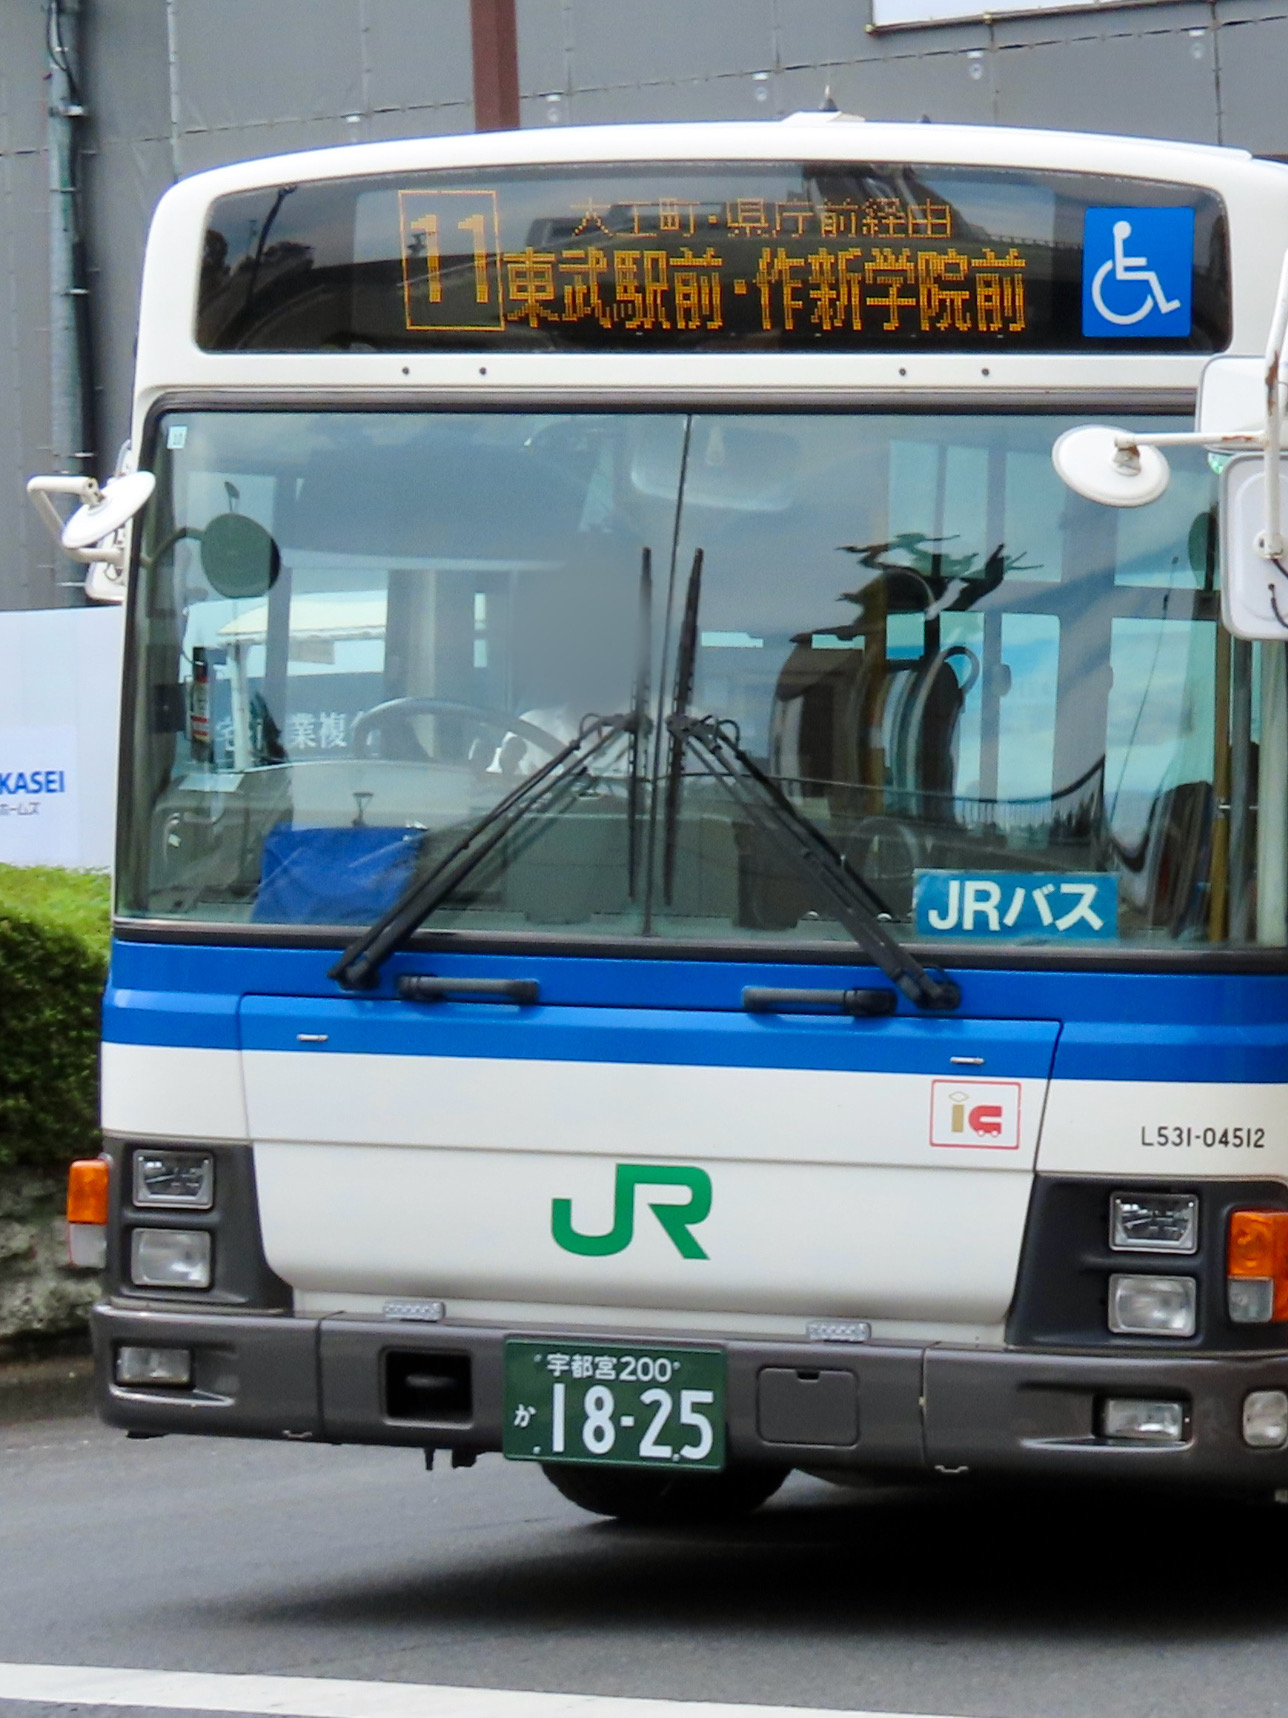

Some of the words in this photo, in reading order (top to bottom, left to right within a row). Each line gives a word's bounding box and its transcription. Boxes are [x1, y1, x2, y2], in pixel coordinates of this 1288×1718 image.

[410, 214, 490, 304] 11
[503, 246, 1026, 332] 東武駅前・作新学院前
[0, 770, 66, 796] KASEI
[927, 879, 1105, 933] JRバス
[1141, 1125, 1266, 1149] L531-04512
[551, 1163, 713, 1261] JR
[513, 1403, 537, 1429] か
[551, 1382, 715, 1461] 18-25
